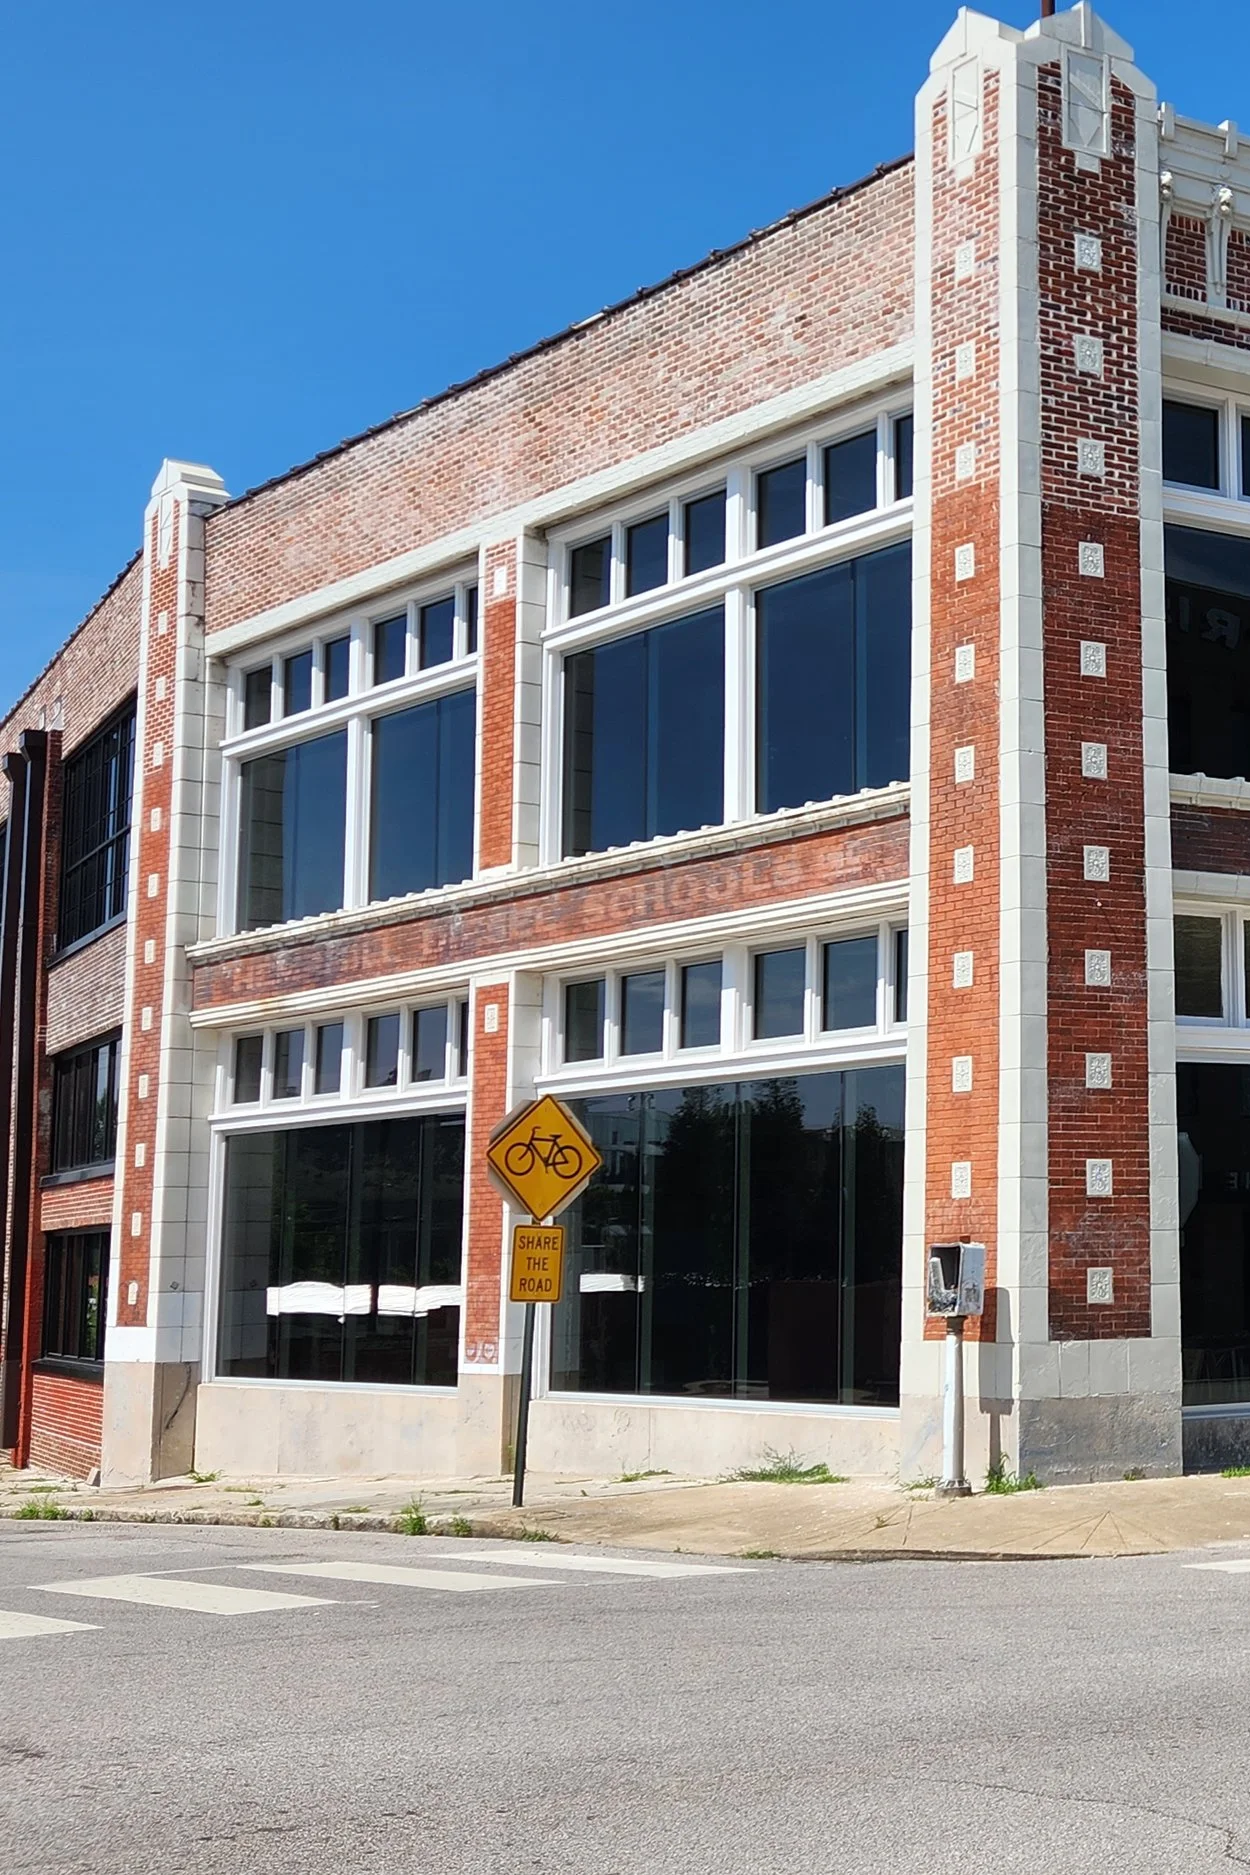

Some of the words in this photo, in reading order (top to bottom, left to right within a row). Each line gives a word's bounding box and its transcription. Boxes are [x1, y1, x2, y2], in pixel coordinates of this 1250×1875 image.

[518, 1235, 559, 1251] SHARE
[526, 1256, 549, 1271] THE
[518, 1277, 553, 1292] ROAD
